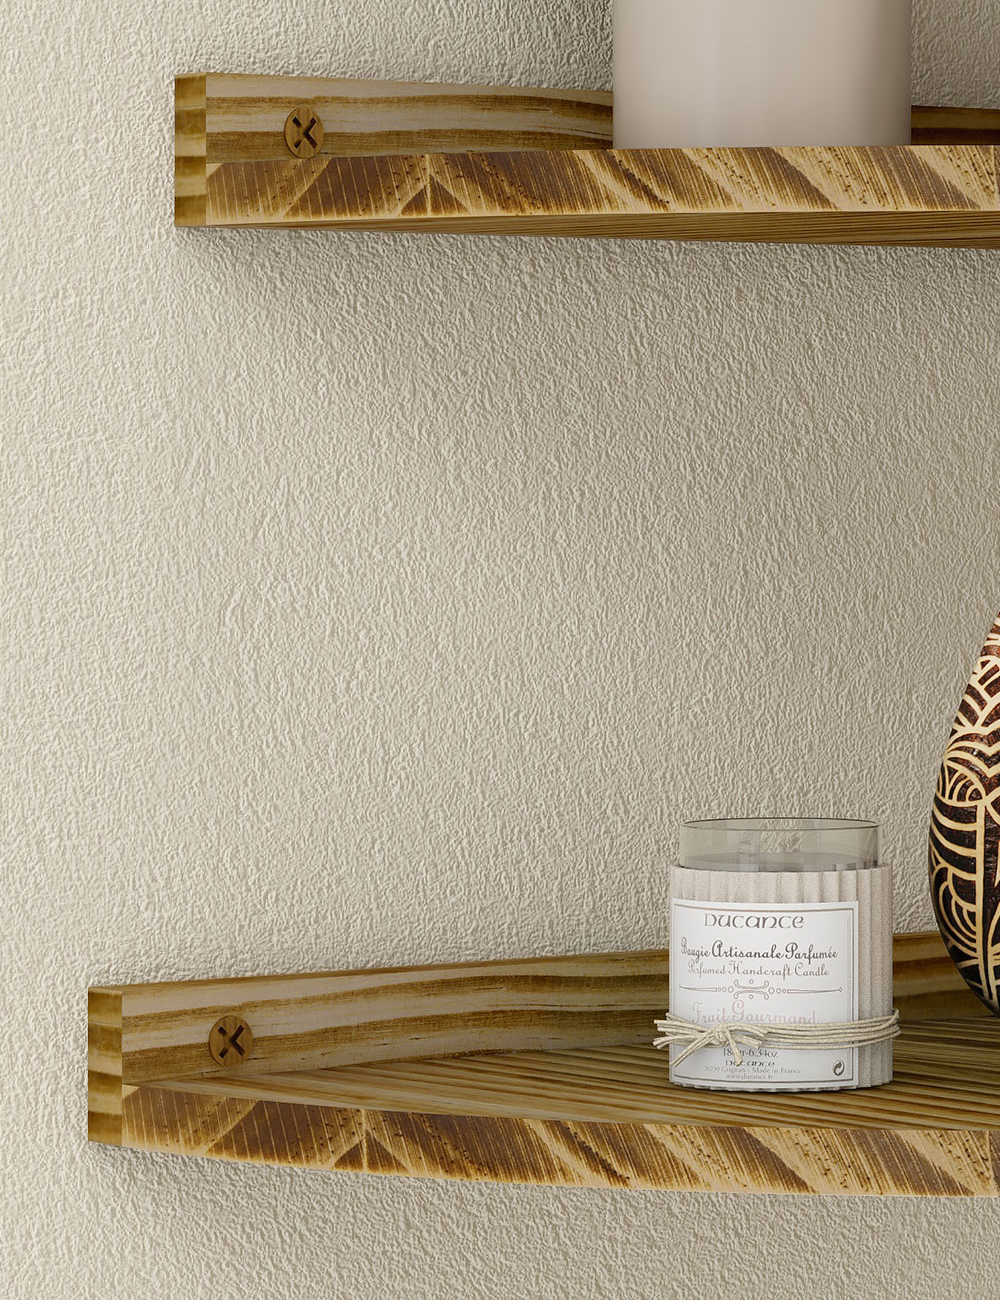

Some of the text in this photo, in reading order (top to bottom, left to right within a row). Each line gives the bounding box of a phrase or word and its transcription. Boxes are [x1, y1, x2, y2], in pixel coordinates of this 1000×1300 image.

[711, 939, 785, 960] Artisanale
[785, 942, 839, 965] Parfumée
[688, 960, 830, 981] Perfumed Handcraft Candle
[692, 999, 819, 1024] Fruit Gourmand
